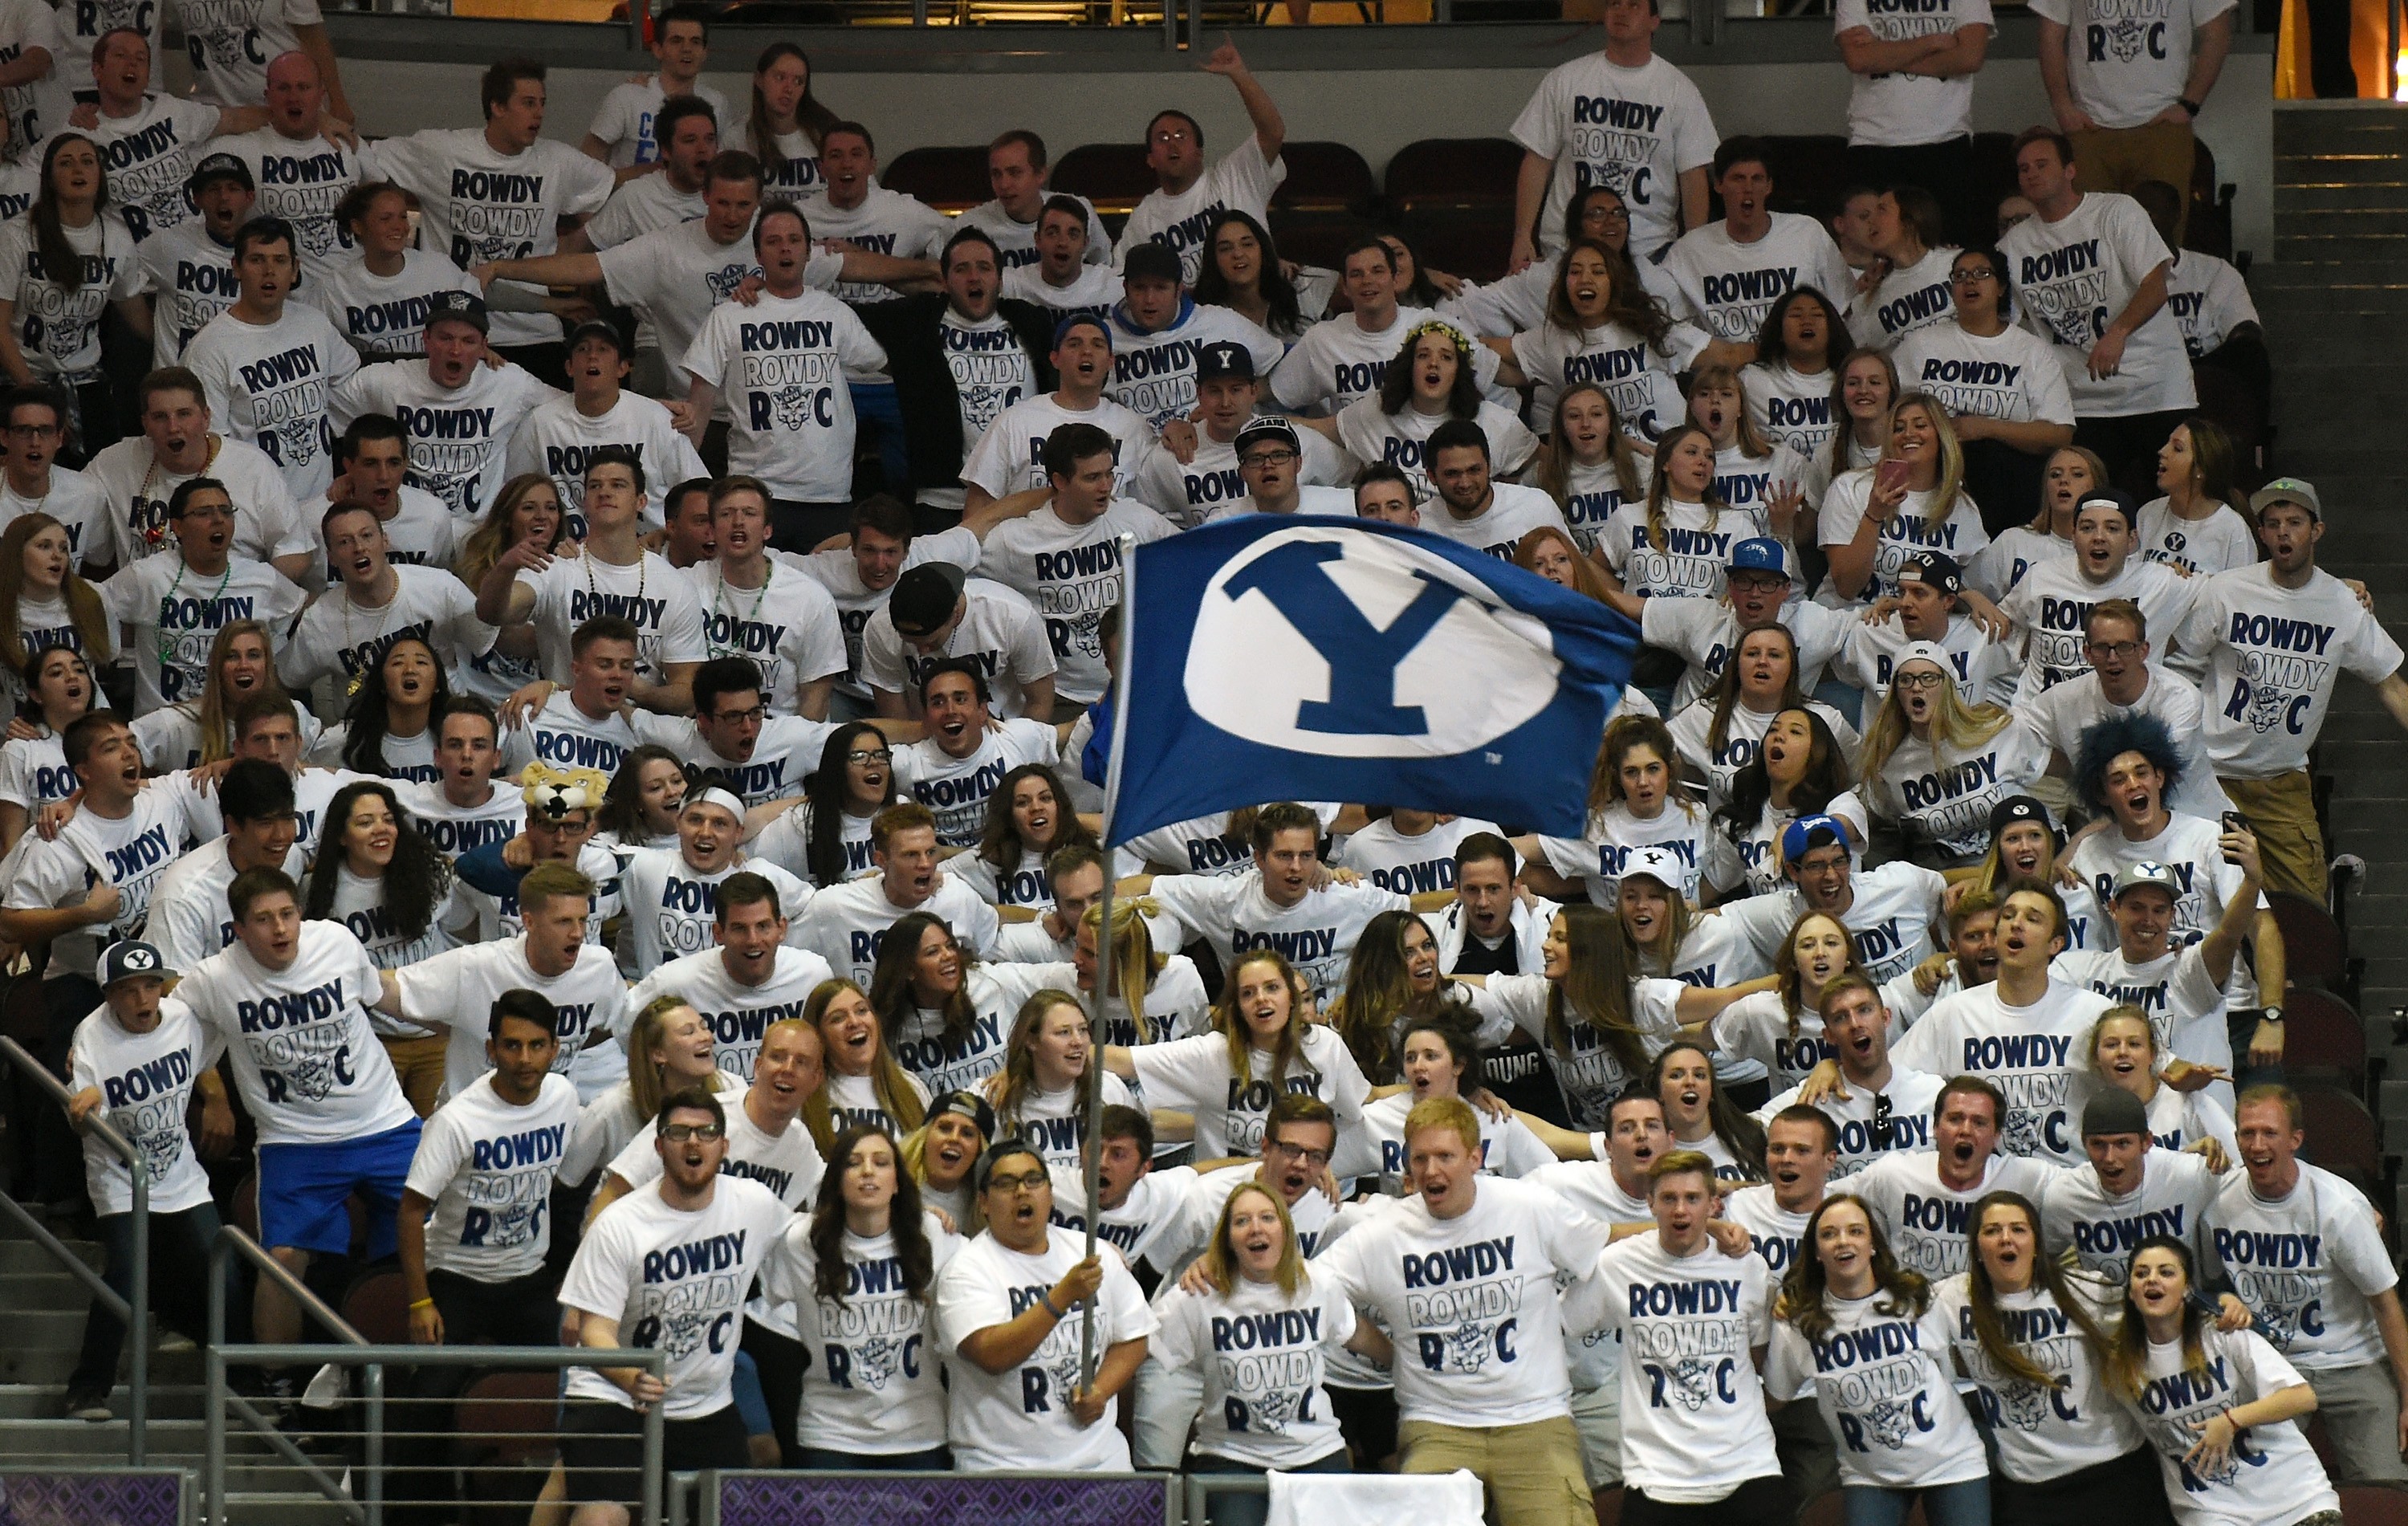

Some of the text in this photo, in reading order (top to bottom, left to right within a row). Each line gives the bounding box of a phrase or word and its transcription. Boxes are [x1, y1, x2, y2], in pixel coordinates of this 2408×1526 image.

[1574, 96, 1663, 132] ROWDY
[99, 117, 178, 172] ROWDY
[1572, 128, 1660, 163] ROWDY
[262, 151, 349, 184] ROWDY
[451, 169, 543, 203] ROWDY
[449, 203, 543, 238] ROWDY
[177, 261, 241, 297] ROW
[2021, 239, 2098, 284] ROWDY
[25, 283, 108, 319] ROWD
[1704, 267, 1797, 305] ROWDY
[2023, 271, 2106, 315] ROWDY
[1706, 307, 1767, 338] ROW
[1878, 281, 1953, 334] ROWD
[742, 320, 832, 352] ROWDY
[240, 344, 320, 393] ROWDY
[744, 353, 837, 387] ROWDY
[1115, 337, 1204, 384] ROWDY
[1216, 350, 1235, 369] Y
[1336, 360, 1389, 393] ROW
[1564, 341, 1645, 384] ROWDY
[1922, 358, 2020, 389] ROWDY
[1116, 372, 1198, 413] ROWD
[1768, 397, 1831, 426] ROW
[397, 408, 494, 440] ROWDY
[1185, 470, 1247, 503] ROW
[1633, 555, 1727, 592] ROWDY
[162, 596, 253, 629] ROWDY
[571, 590, 668, 629] ROWDY
[1039, 577, 1120, 615] ROWD
[1222, 539, 1466, 735] Y
[2230, 612, 2335, 656] ROWDY
[914, 758, 1006, 805] ROWDY
[1902, 751, 1997, 811] ROWDY
[416, 819, 515, 853] ROWDY
[1373, 857, 1456, 893] ROWD
[1644, 852, 1664, 865] Y
[2140, 862, 2163, 877] Y
[662, 877, 719, 909] ROW
[128, 952, 148, 968] Y
[238, 977, 347, 1033] ROWDY
[245, 1015, 353, 1065] ROWDY
[1964, 1036, 2072, 1071] ROWDY
[104, 1045, 192, 1109] ROWDY
[1485, 1051, 1540, 1084] OUNG
[474, 1123, 566, 1170] ROWDY
[1903, 1194, 1972, 1233] ROW
[644, 1229, 746, 1283] ROWDY
[1403, 1235, 1515, 1288] ROWDY
[1900, 1234, 1971, 1273] ROW
[2213, 1228, 2321, 1268] ROWDY
[832, 1257, 905, 1295] OWD
[2234, 1270, 2322, 1304] OWD
[818, 1297, 928, 1338] ROWDY
[1405, 1275, 1524, 1328] ROWDY
[1629, 1280, 1742, 1317] ROWDY
[1212, 1307, 1320, 1351] ROWDY
[1633, 1319, 1743, 1359] ROWDY
[1812, 1322, 1919, 1373] ROWDY
